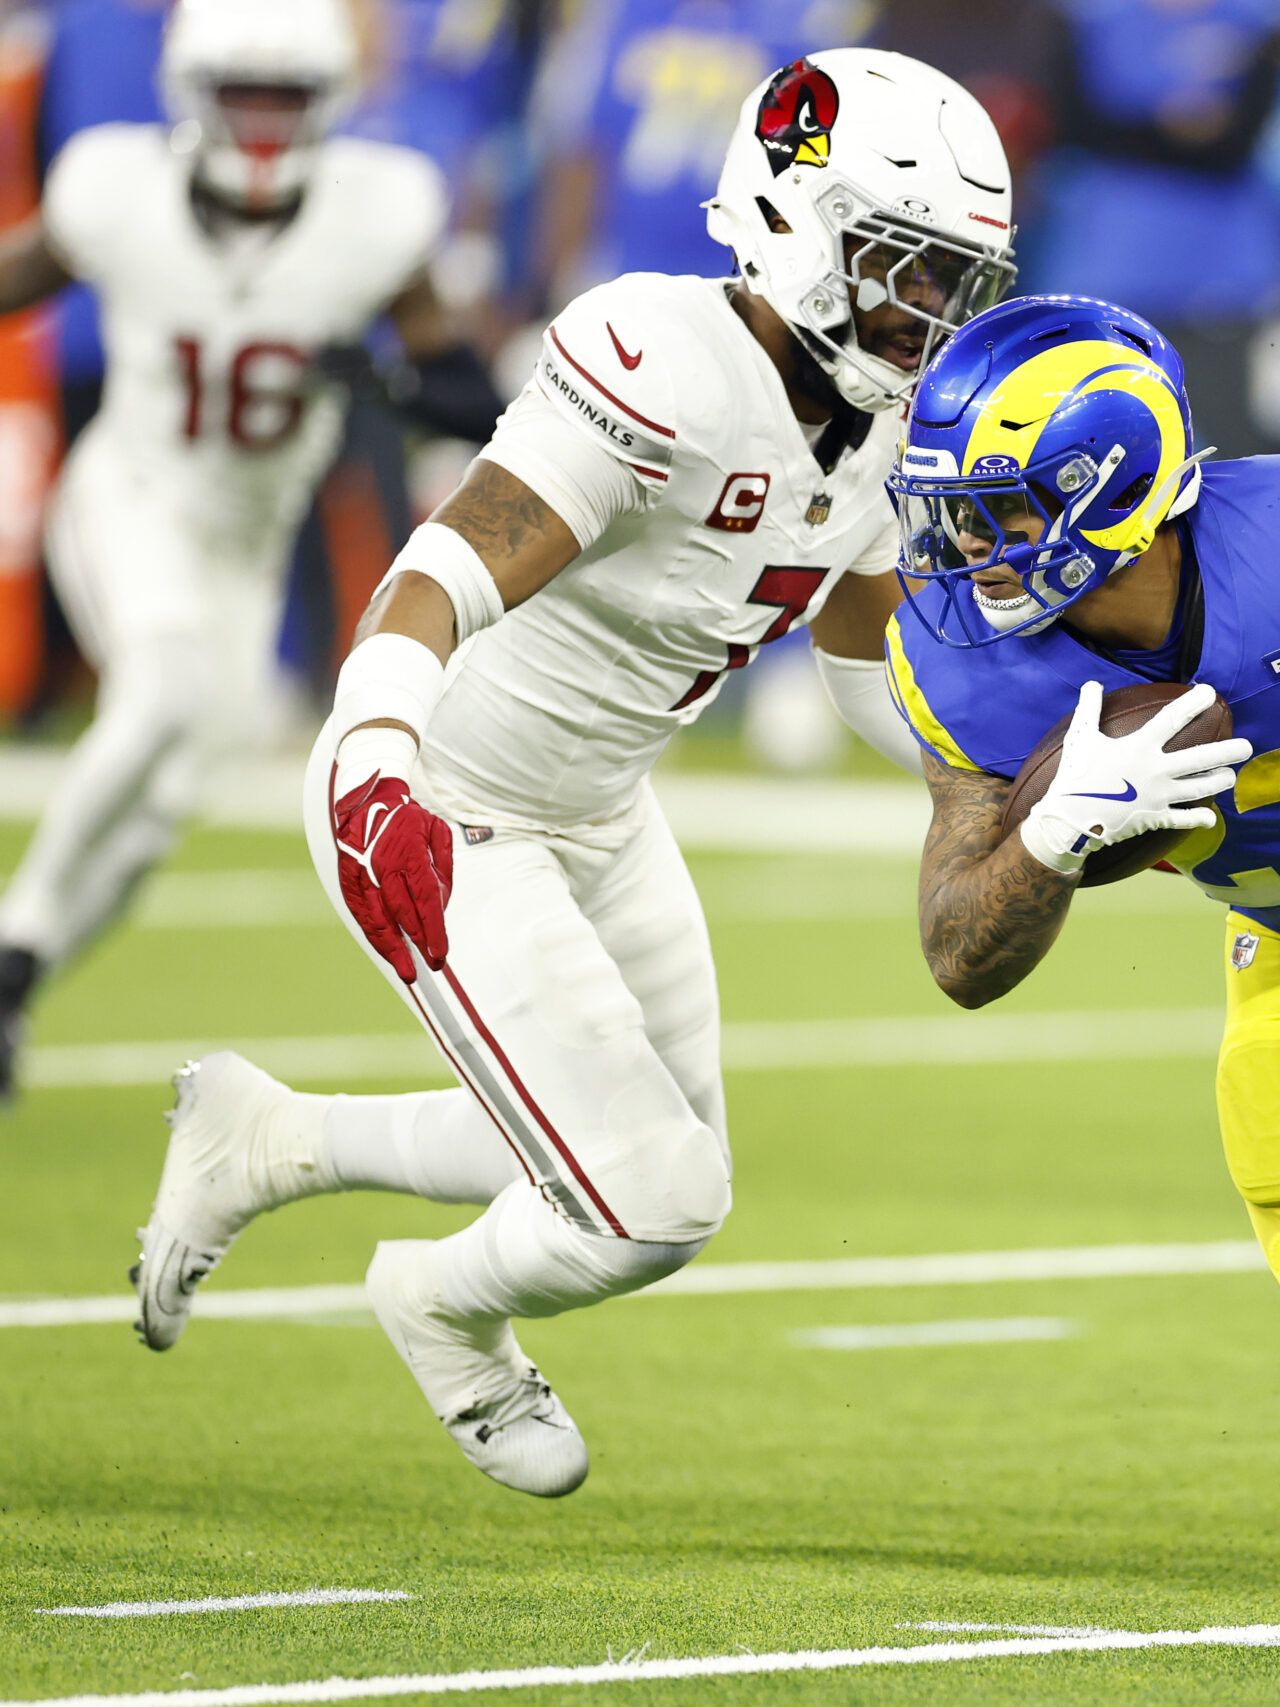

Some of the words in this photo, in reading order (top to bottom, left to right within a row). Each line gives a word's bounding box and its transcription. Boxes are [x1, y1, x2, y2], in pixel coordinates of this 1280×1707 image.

[172, 336, 316, 455] 16
[545, 363, 635, 447] CARDINALS
[720, 477, 767, 519] C
[974, 466, 1018, 475] OAKLEY
[667, 564, 832, 712] 7
